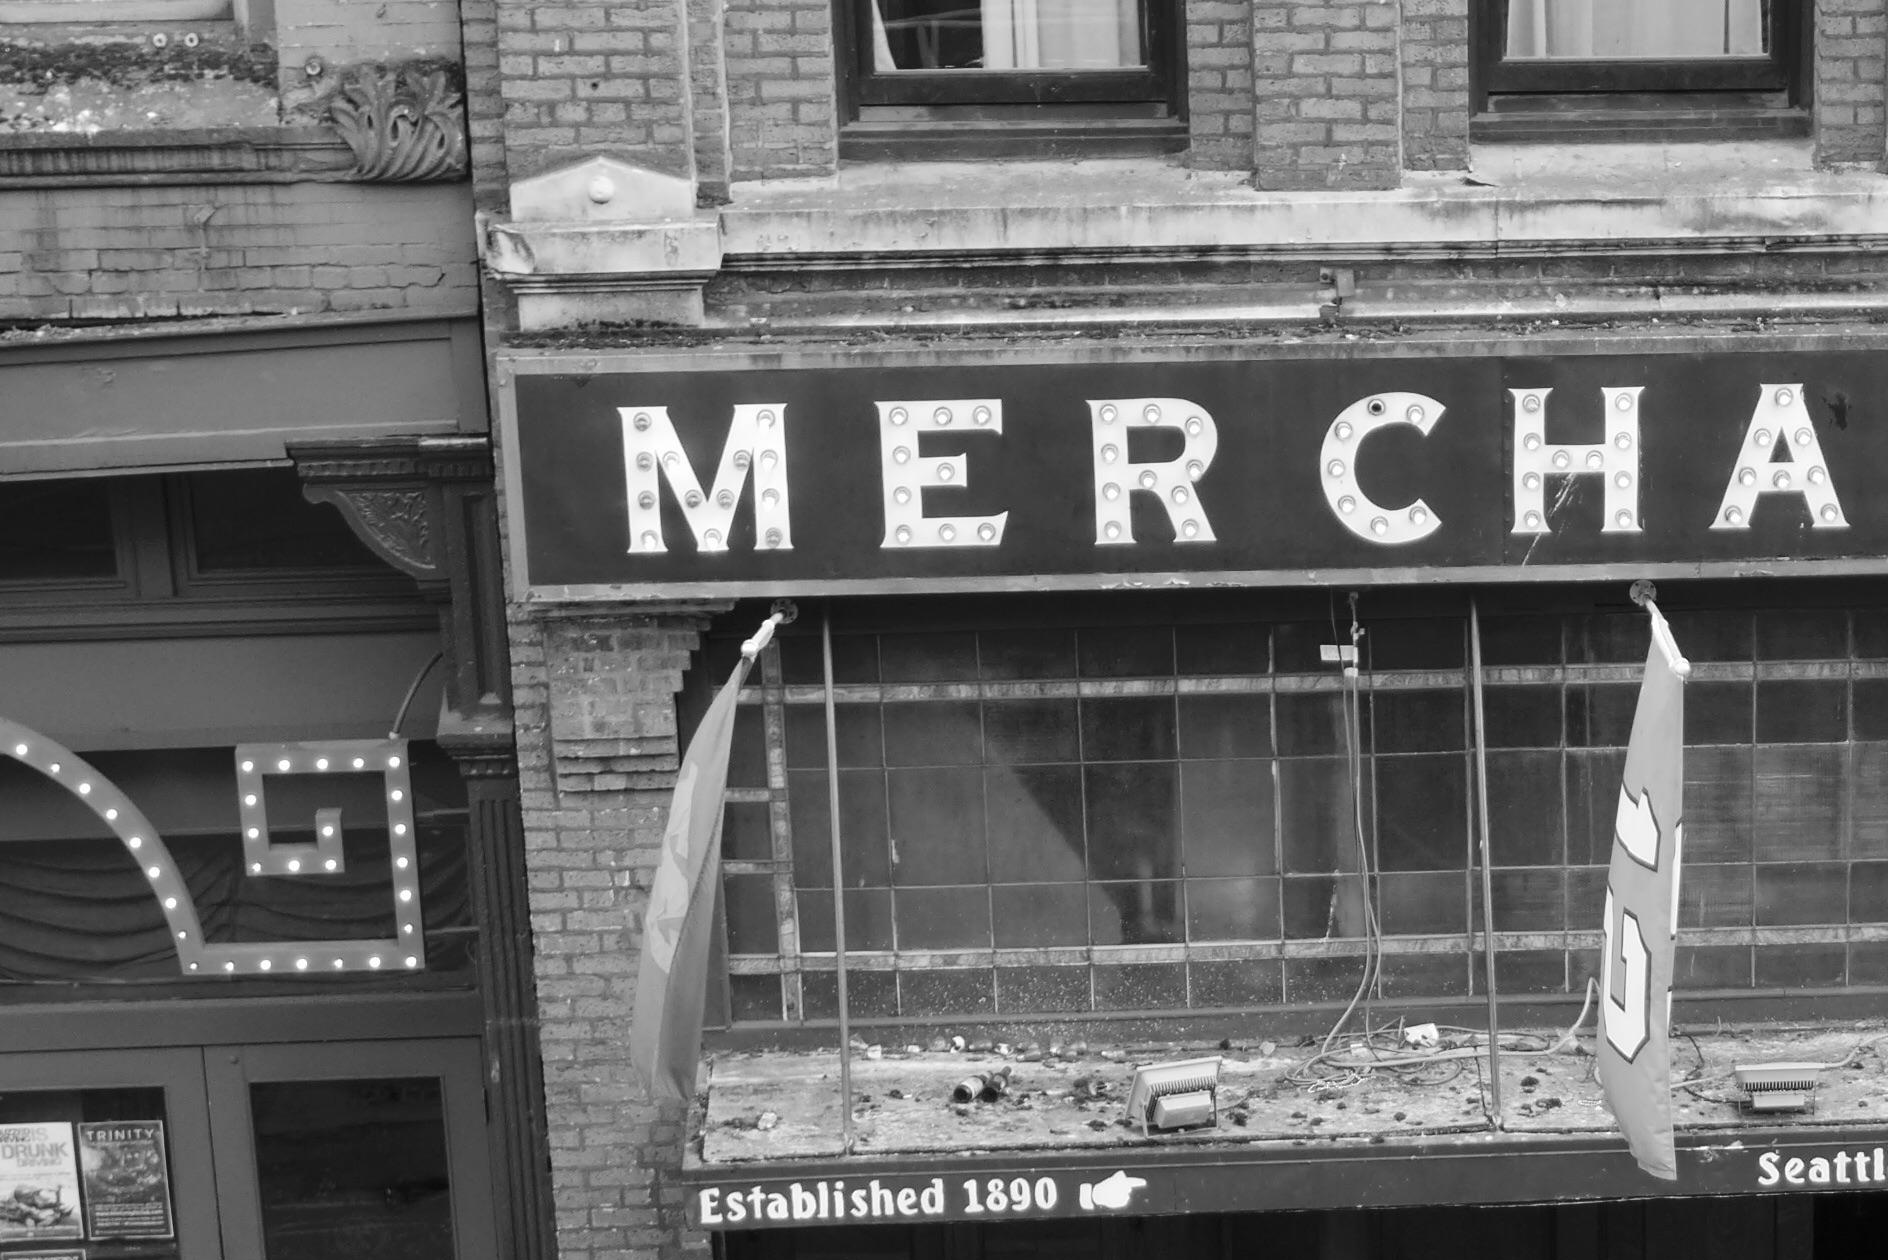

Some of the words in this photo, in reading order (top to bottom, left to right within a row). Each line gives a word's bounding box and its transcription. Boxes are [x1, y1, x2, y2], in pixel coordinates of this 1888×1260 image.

[86, 1128, 155, 1142] TRINITY
[2, 1142, 69, 1159] DRUNK
[699, 1178, 925, 1224] Established
[963, 1176, 1058, 1214] 1890
